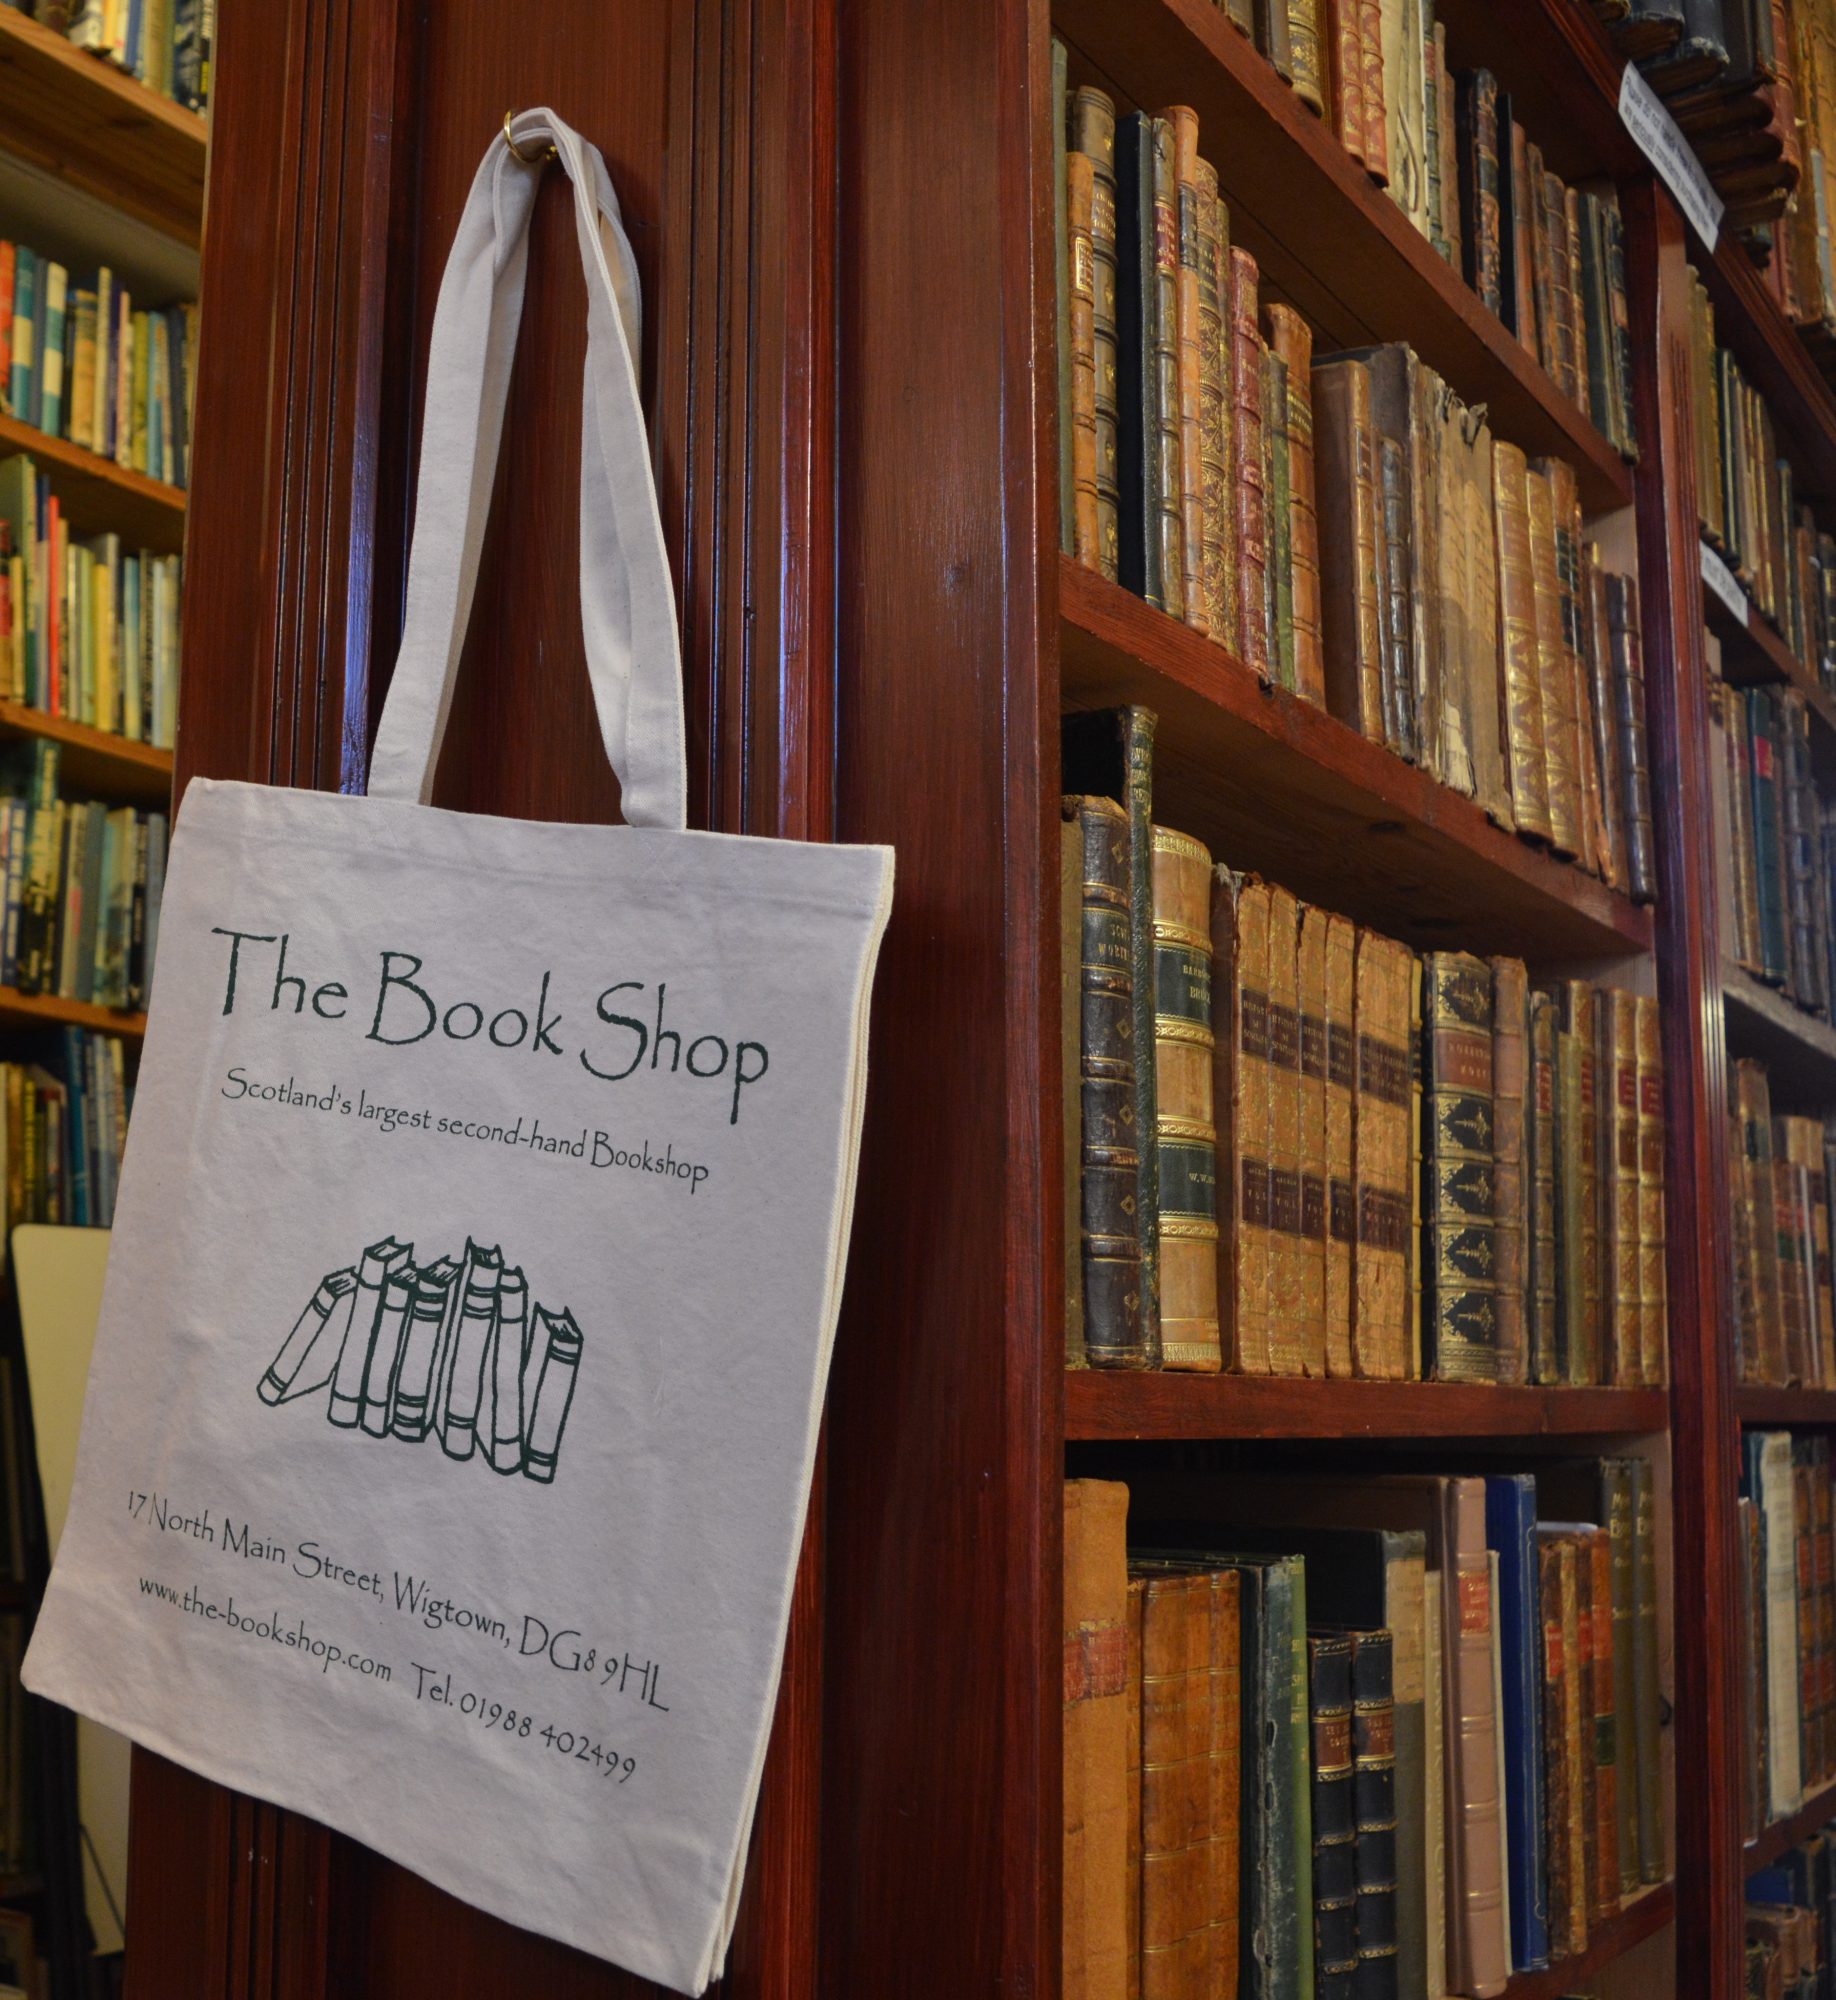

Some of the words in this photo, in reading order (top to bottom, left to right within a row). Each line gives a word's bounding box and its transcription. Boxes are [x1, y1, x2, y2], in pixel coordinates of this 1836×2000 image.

[211, 927, 348, 1019] The
[365, 951, 563, 1055] Book
[580, 982, 769, 1125] Shop
[222, 1067, 351, 1116] Scotland's
[358, 1089, 431, 1132] largest
[437, 1117, 587, 1157] second-hand
[590, 1131, 709, 1195] Bookshop
[129, 1491, 147, 1518] 17
[149, 1493, 214, 1542] North
[222, 1518, 285, 1563] Main
[293, 1542, 383, 1603] Street,
[394, 1571, 510, 1648] Wigtown,
[519, 1615, 596, 1672] DG8
[600, 1653, 669, 1712] 9HL
[140, 1576, 391, 1681] www.the-bookshop.com
[411, 1662, 453, 1706] Tel.
[460, 1693, 532, 1737] 01988
[540, 1725, 635, 1783] 402499
